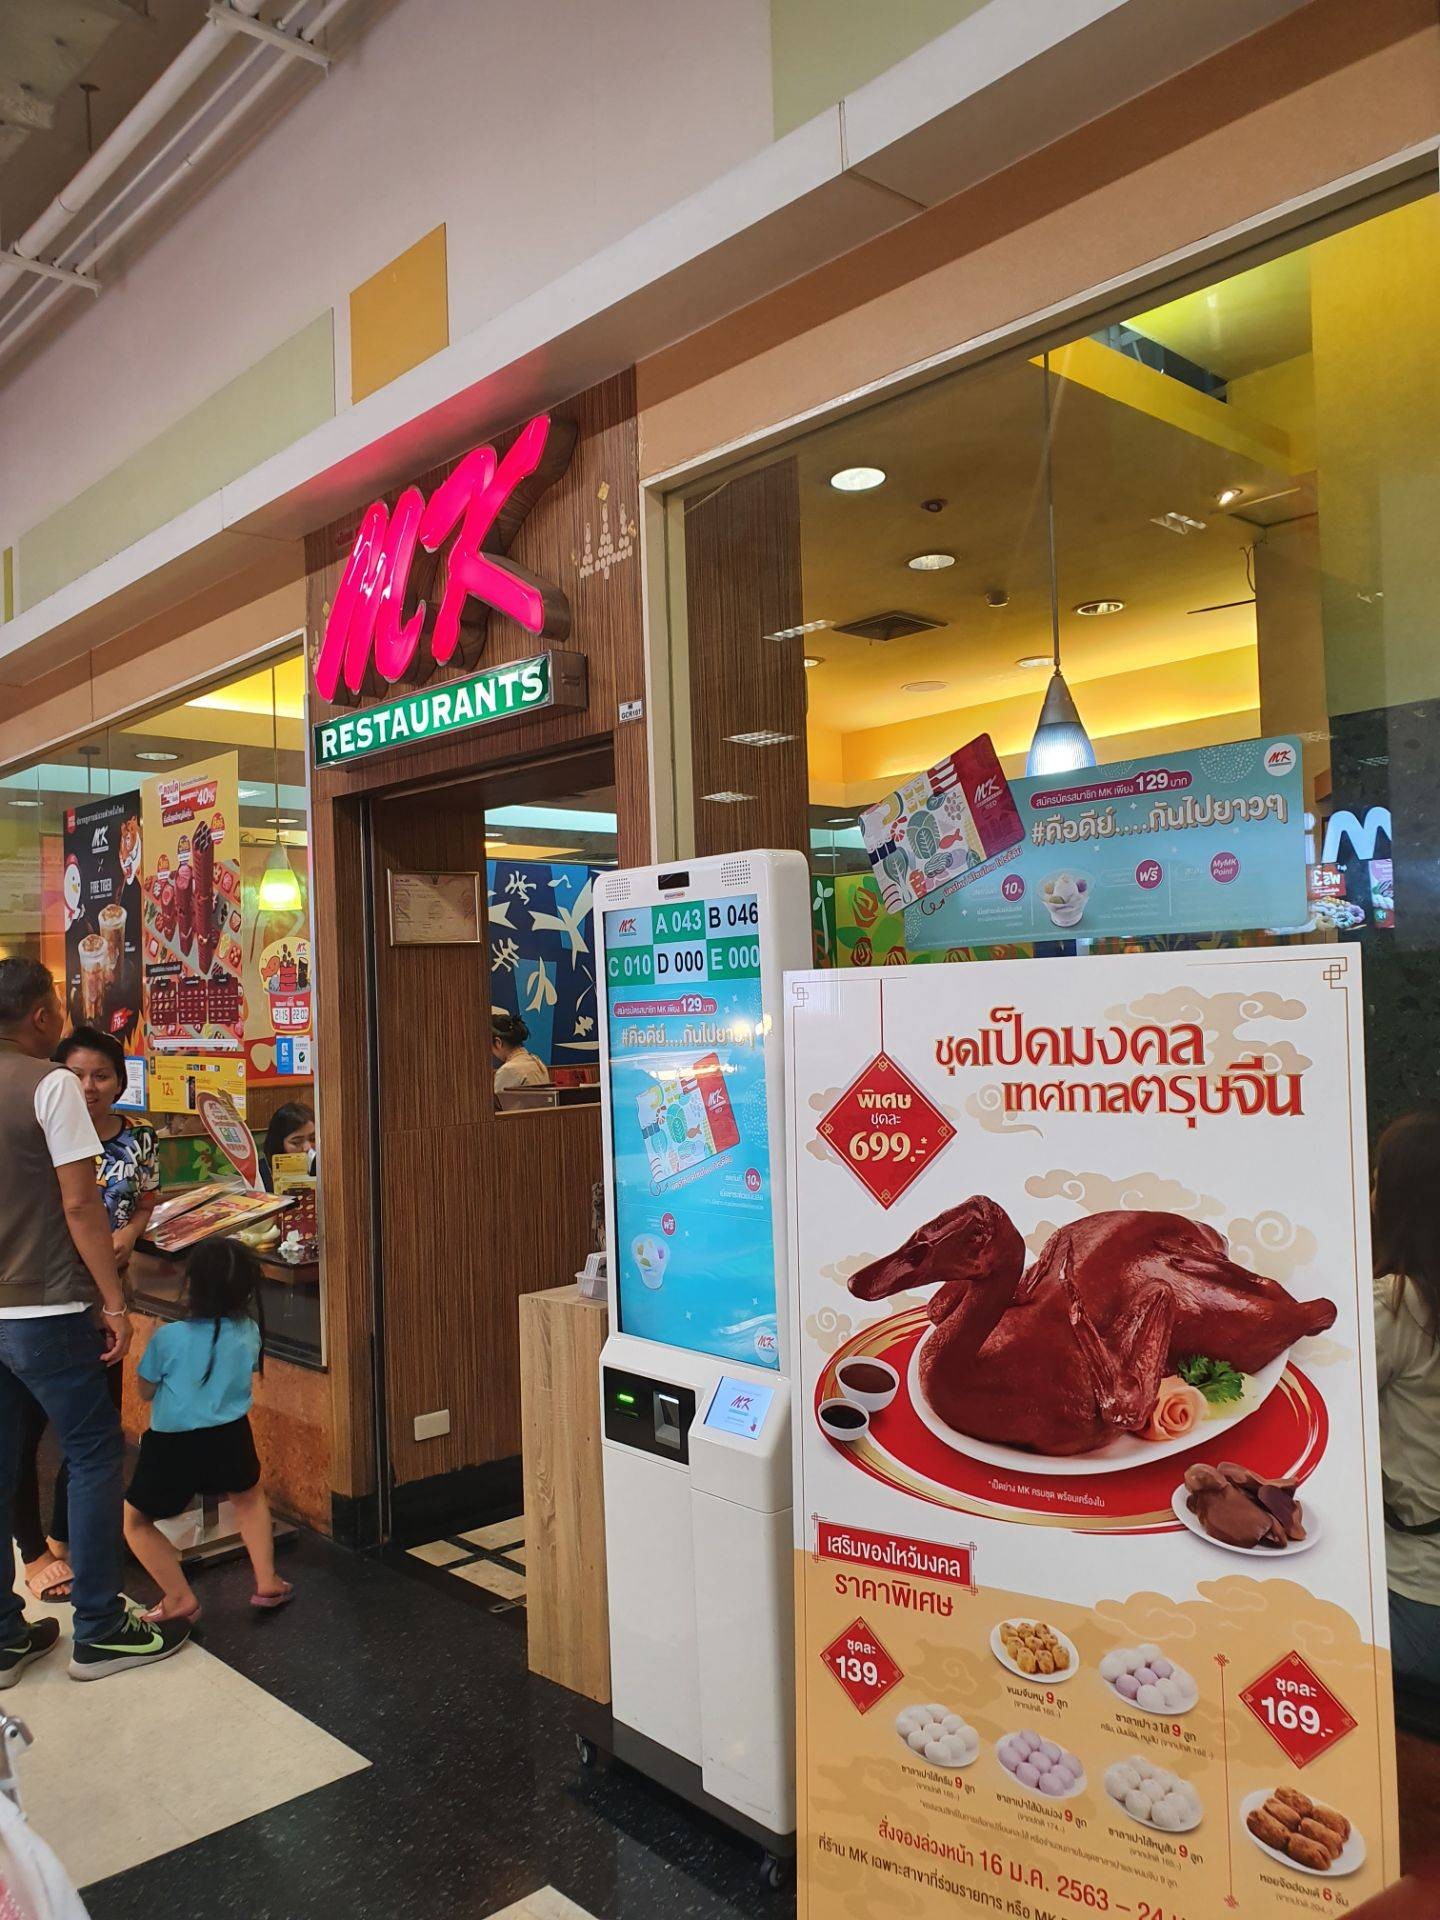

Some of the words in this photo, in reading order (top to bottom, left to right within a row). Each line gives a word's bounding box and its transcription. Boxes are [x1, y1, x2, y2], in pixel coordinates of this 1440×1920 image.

[315, 415, 550, 703] MK
[321, 666, 543, 758] RESTAURANTS
[1268, 750, 1291, 763] MK
[974, 775, 1000, 803] MK
[1036, 792, 1097, 807] สมัครบัตรสมาชิก
[1099, 788, 1113, 797] MK
[1114, 785, 1134, 798] เพียง
[1136, 773, 1168, 792] 129
[1171, 777, 1188, 788] บาท
[1139, 866, 1159, 882] ฟรี
[1212, 858, 1237, 870] MyMK
[1213, 867, 1233, 876] Point
[619, 918, 637, 932] MK
[656, 912, 668, 934] A
[672, 908, 702, 932] 043
[709, 907, 721, 929] B
[728, 902, 759, 927] 046
[608, 958, 619, 977] C
[624, 954, 651, 976] 010
[658, 953, 669, 974] D
[675, 950, 704, 973] 000
[711, 948, 723, 970] E
[729, 945, 760, 969] 000
[681, 998, 702, 1013] 129
[935, 1006, 1206, 1077] ชุดเป็ดมงคล
[856, 1088, 912, 1110] พิเศษ
[1002, 1056, 1306, 1129] เทศกาลตรุษจีน
[871, 1113, 902, 1129] ชุดละ
[758, 1334, 775, 1349] MK
[731, 1395, 754, 1410] MK
[1017, 1485, 1030, 1495] MK
[1031, 1488, 1055, 1501] ครบชุด
[827, 1534, 961, 1578] เสริมของไหว้มงคล
[835, 1573, 954, 1617] ราคาพิเศษ
[847, 1638, 876, 1659] ชุดละ
[835, 1656, 887, 1689] 139.-
[1007, 1685, 1044, 1705] ขนมจีบหมู
[1046, 1691, 1054, 1704] 9
[1056, 1699, 1068, 1710] ลูก
[1275, 1676, 1317, 1698] ชุดละ
[1115, 1713, 1150, 1728] ซาลาเปา
[1152, 1723, 1158, 1732] 3
[1160, 1722, 1170, 1734] ไส้
[1172, 1723, 1181, 1737] 9
[1184, 1731, 1197, 1743] ลูก
[1260, 1696, 1334, 1738] 169.-
[955, 1776, 963, 1789] 9
[964, 1784, 975, 1795] ลูก
[996, 1792, 1062, 1820] ซาลาเปาไส้มันม่วง
[1064, 1808, 1073, 1822] 9
[1075, 1817, 1087, 1829] ลูก
[879, 1815, 974, 1867] สั่งจองล่วงหน้า
[979, 1849, 1003, 1876] 16
[1009, 1861, 1049, 1892] ม.ค.
[1057, 1875, 1109, 1911] 2563
[1179, 1844, 1188, 1858] 9
[1190, 1853, 1203, 1865] ลูก
[818, 1833, 845, 1857] ที่ร้าน
[849, 1848, 868, 1865] MK
[871, 1854, 1003, 1911] เฉพาะสาขาที่ร่วมรายการ
[1006, 1900, 1030, 1919] หรือ
[1322, 1887, 1332, 1901] 6
